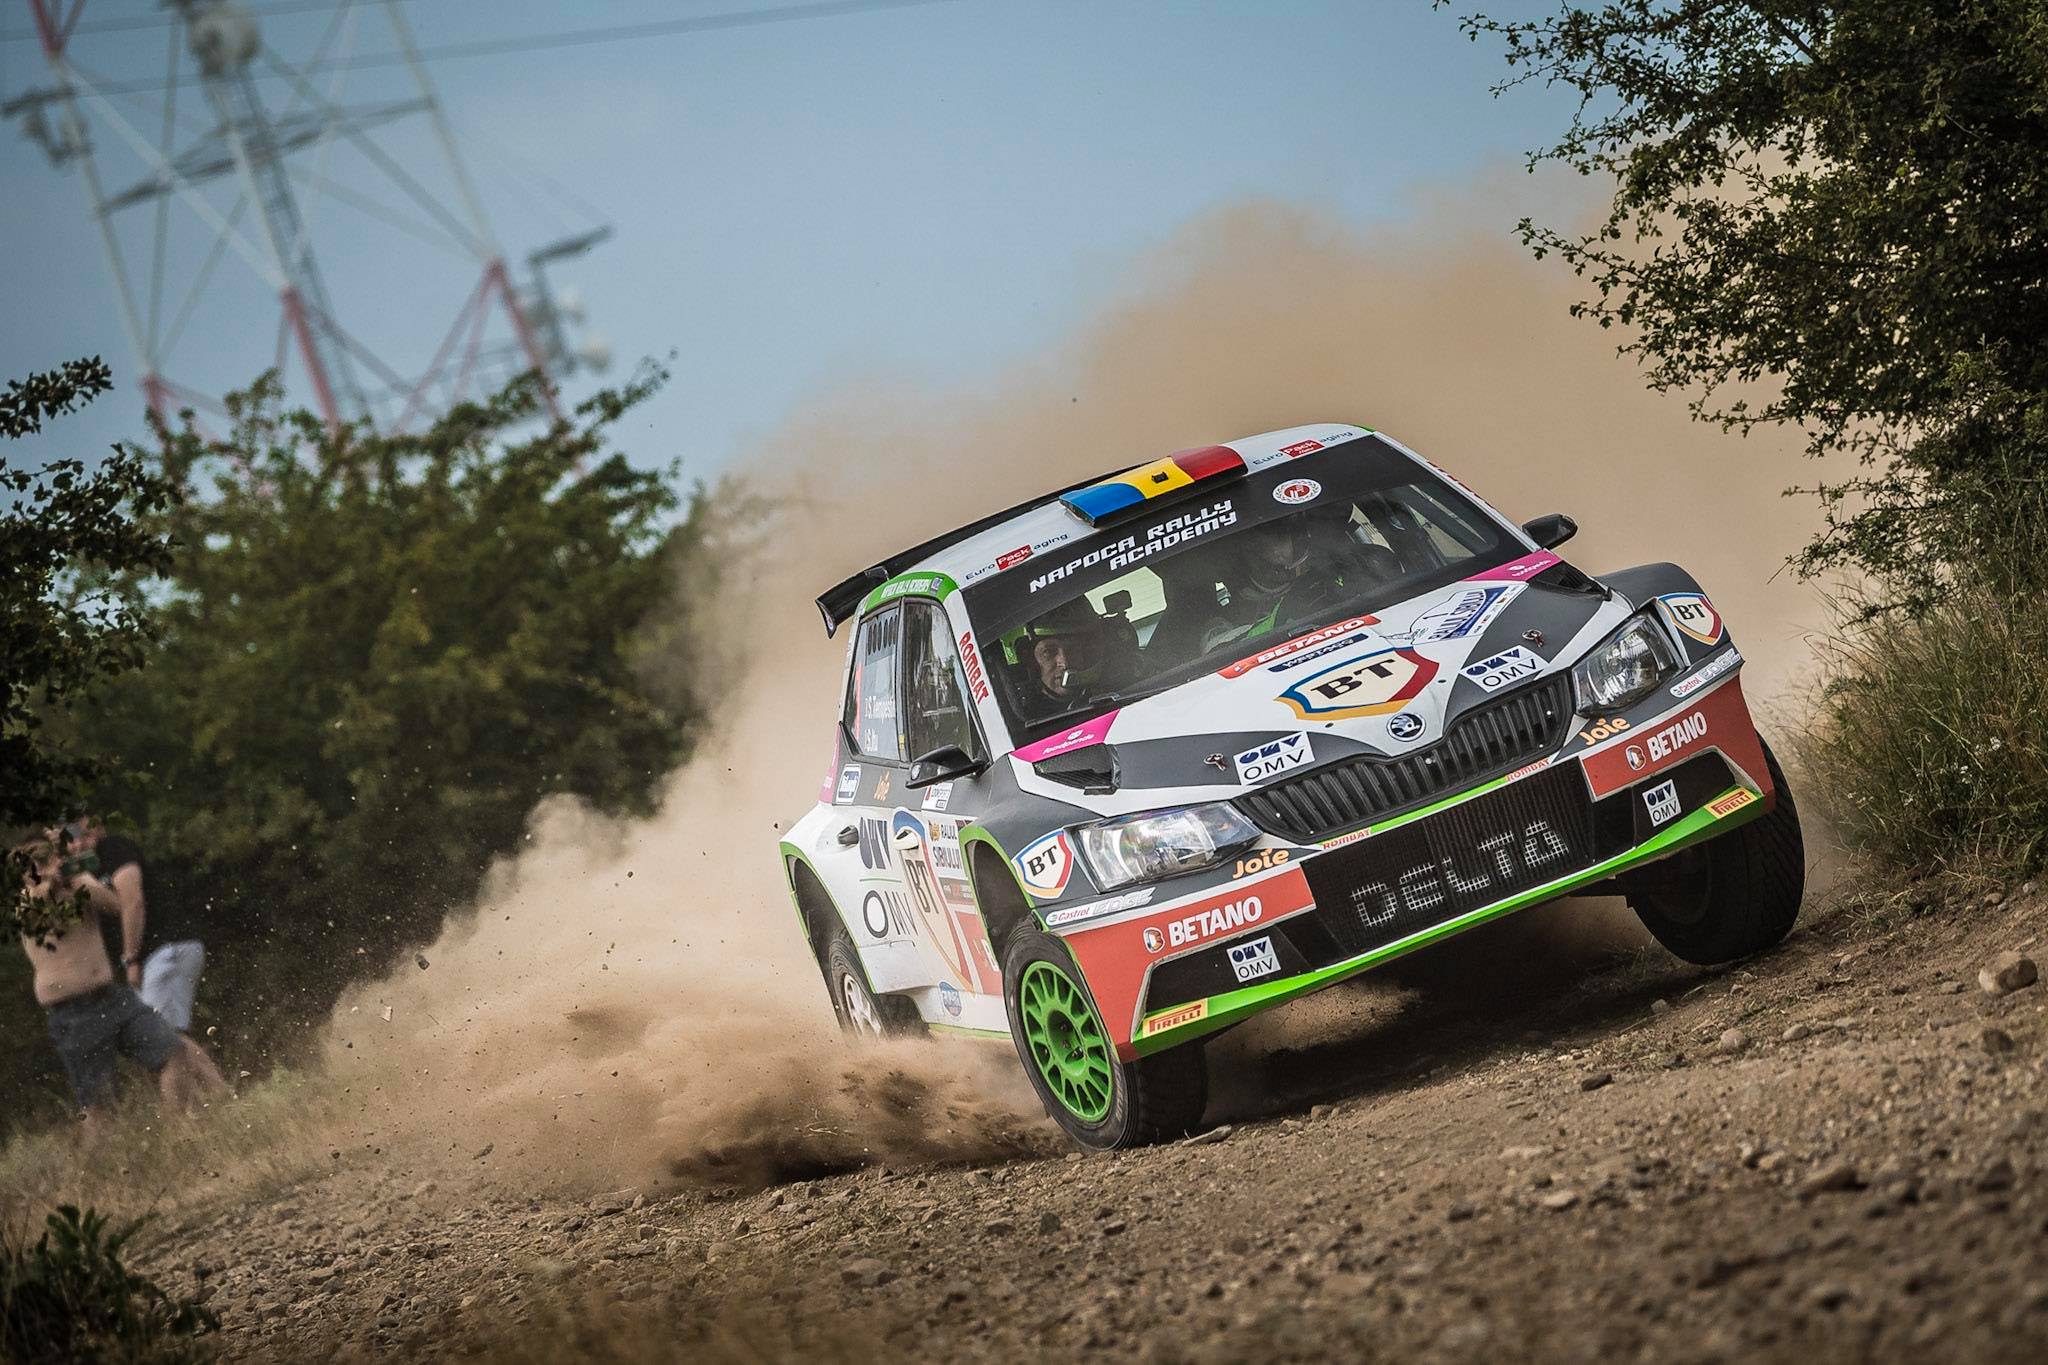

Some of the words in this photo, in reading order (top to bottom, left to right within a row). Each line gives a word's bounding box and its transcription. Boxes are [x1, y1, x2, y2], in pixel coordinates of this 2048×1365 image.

[1029, 535, 1137, 593] NAPOCA
[1147, 500, 1233, 541] RALLY
[1110, 511, 1237, 571] ACADEMY
[1673, 601, 1706, 622] BT
[1257, 619, 1364, 663] BETANO
[959, 631, 989, 704] ROMBAT
[1311, 659, 1396, 700] BT
[1483, 659, 1539, 687] OMV
[1578, 717, 1631, 746] Joie
[1646, 711, 1708, 762] BETANO
[1244, 749, 1304, 780] OMV
[1505, 759, 1550, 782] ROMBAT
[1652, 800, 1678, 823] OMV
[1711, 790, 1751, 816] PIRELLI
[1323, 828, 1371, 850] ROMBAT
[1025, 845, 1058, 877] BT
[1232, 848, 1290, 879] Joie
[1351, 818, 1570, 928] DELTA
[905, 859, 939, 914] BT
[863, 889, 918, 938] OMV
[1058, 906, 1090, 922] Castrol
[1168, 896, 1262, 947] BETANO
[1238, 957, 1275, 980] OMV
[1149, 1004, 1202, 1033] PIRELLI
